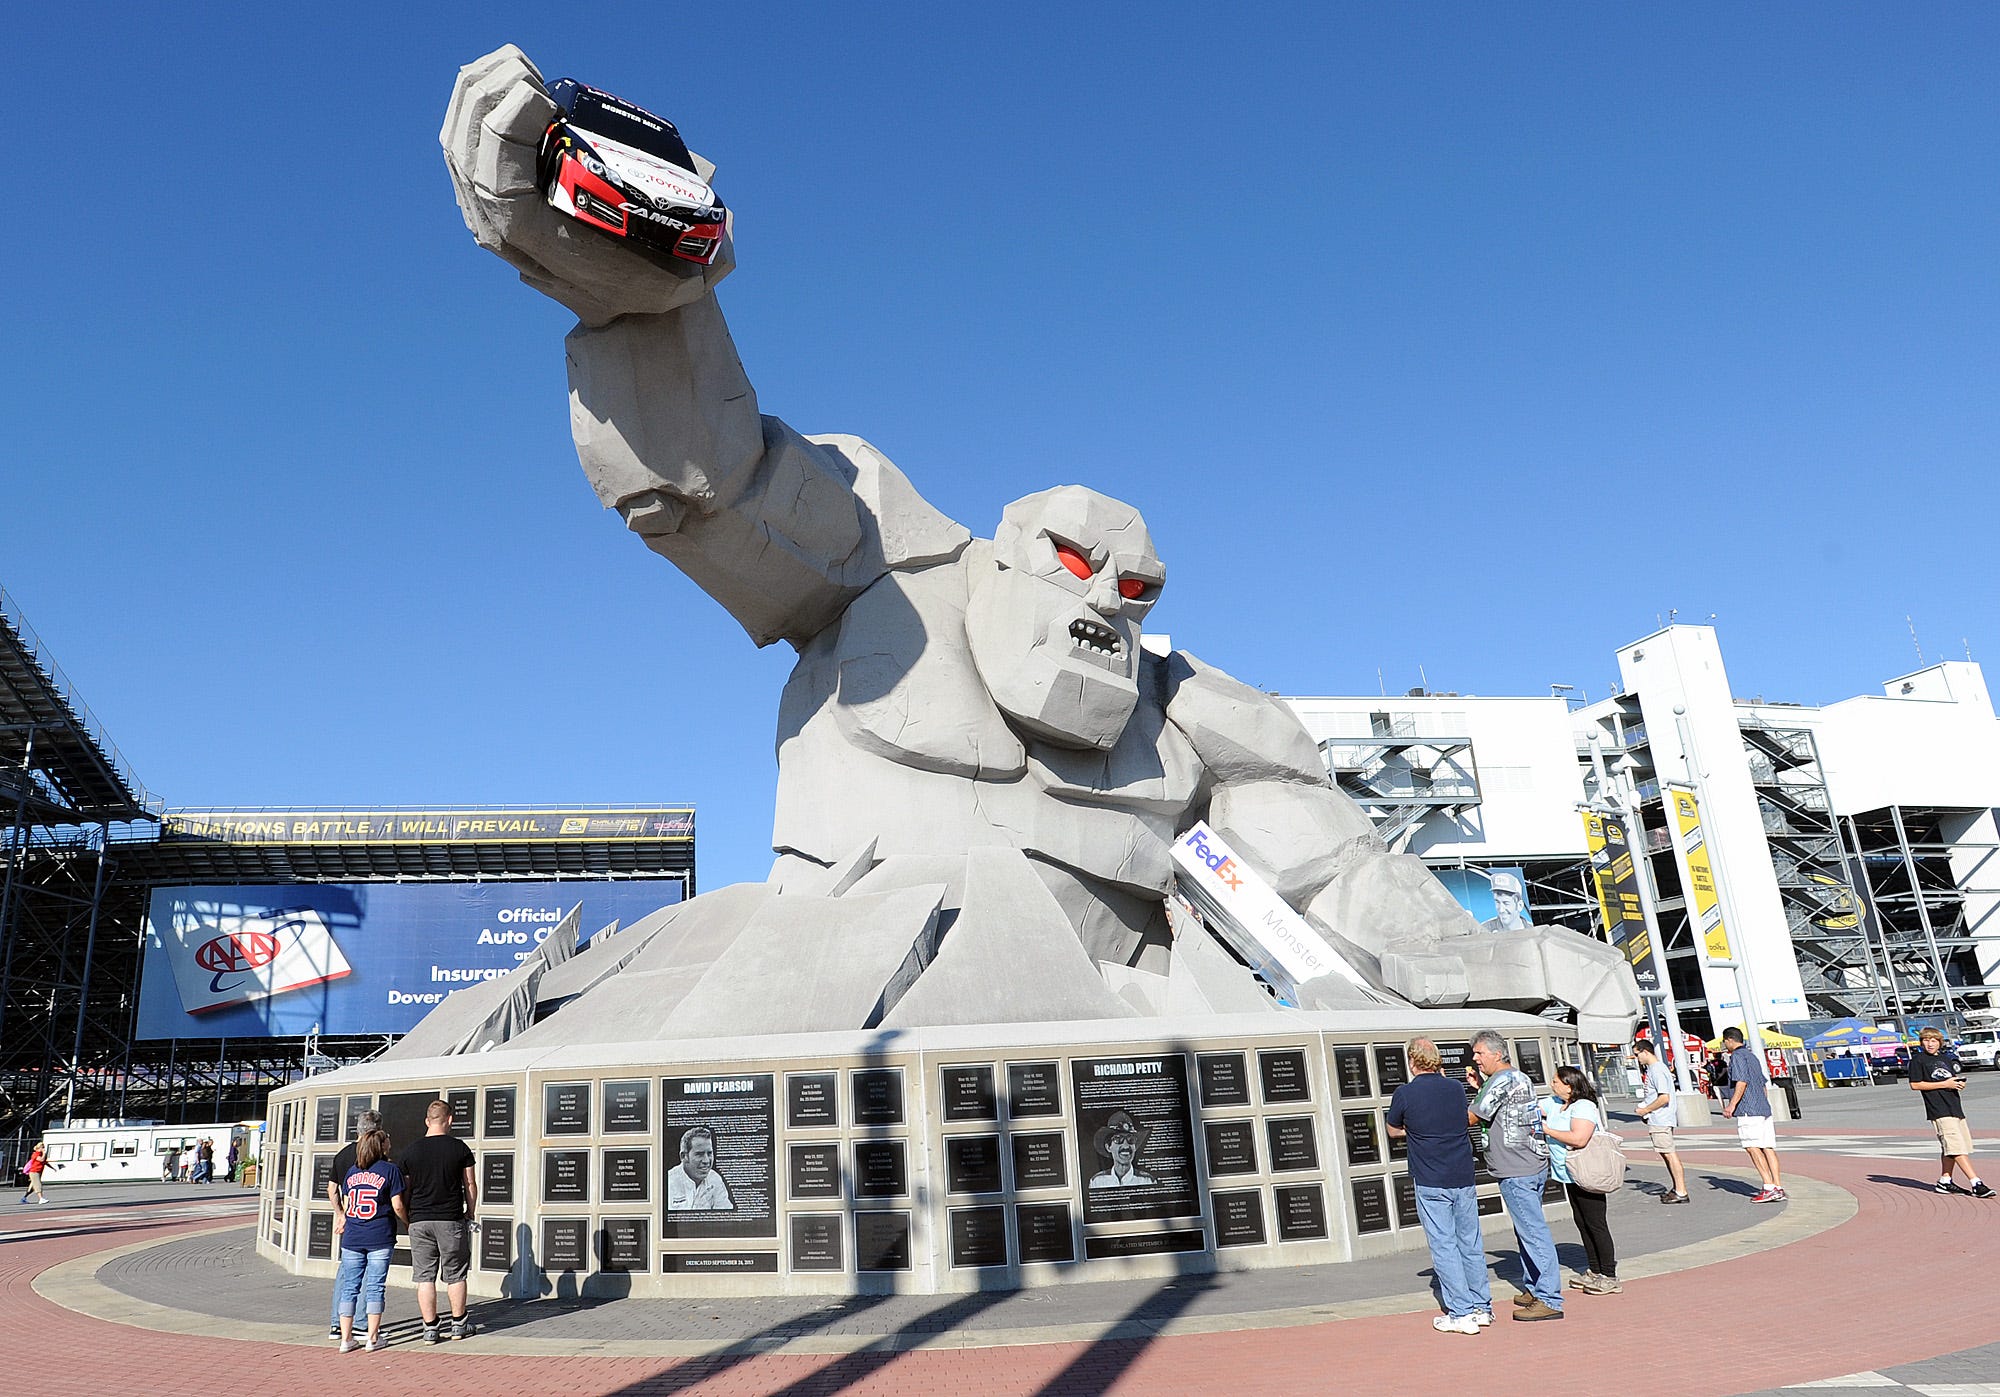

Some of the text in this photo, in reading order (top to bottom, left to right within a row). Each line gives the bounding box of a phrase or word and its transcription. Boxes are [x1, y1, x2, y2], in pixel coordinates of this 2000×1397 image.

[601, 102, 663, 132] MONSTER MILE
[648, 174, 697, 202] TOYOTA
[618, 201, 697, 233] CAMRY
[193, 822, 285, 835] NATIONS
[292, 821, 375, 835] BATTLE.
[383, 821, 394, 834] 1
[402, 820, 449, 834] WILL
[456, 820, 546, 834] PREVAIL.
[1185, 829, 1245, 892] FedEx
[497, 908, 561, 923] Official
[477, 928, 528, 945] Auto
[1261, 909, 1324, 972] Monster
[209, 933, 274, 972] AAA
[388, 991, 443, 1005] Dover
[1094, 1061, 1162, 1077] RICHARD PETTY
[684, 1080, 754, 1094] DAVID PEARSON
[346, 1171, 386, 1190] PEDROIA
[346, 1188, 379, 1220] 15
